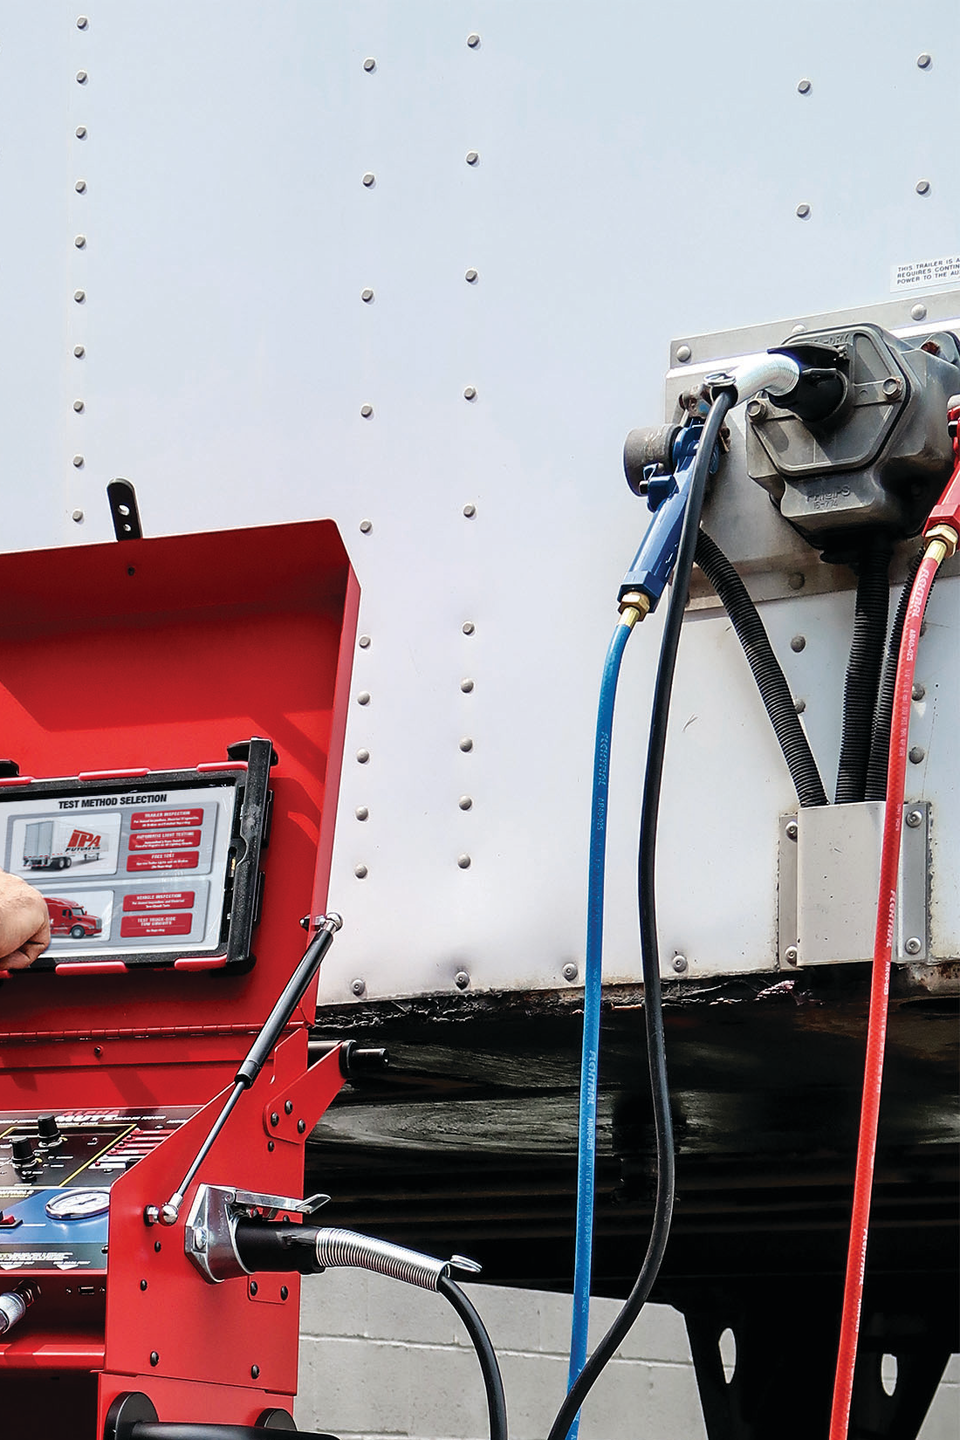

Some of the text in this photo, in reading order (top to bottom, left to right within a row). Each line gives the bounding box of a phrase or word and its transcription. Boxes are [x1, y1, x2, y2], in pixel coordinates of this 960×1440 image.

[916, 260, 943, 269] TRAILER
[897, 268, 932, 278] REQUIRES
[897, 276, 920, 284] POWER
[58, 794, 167, 809] TEST METHOD SELECTION
[67, 829, 101, 847] IPA
